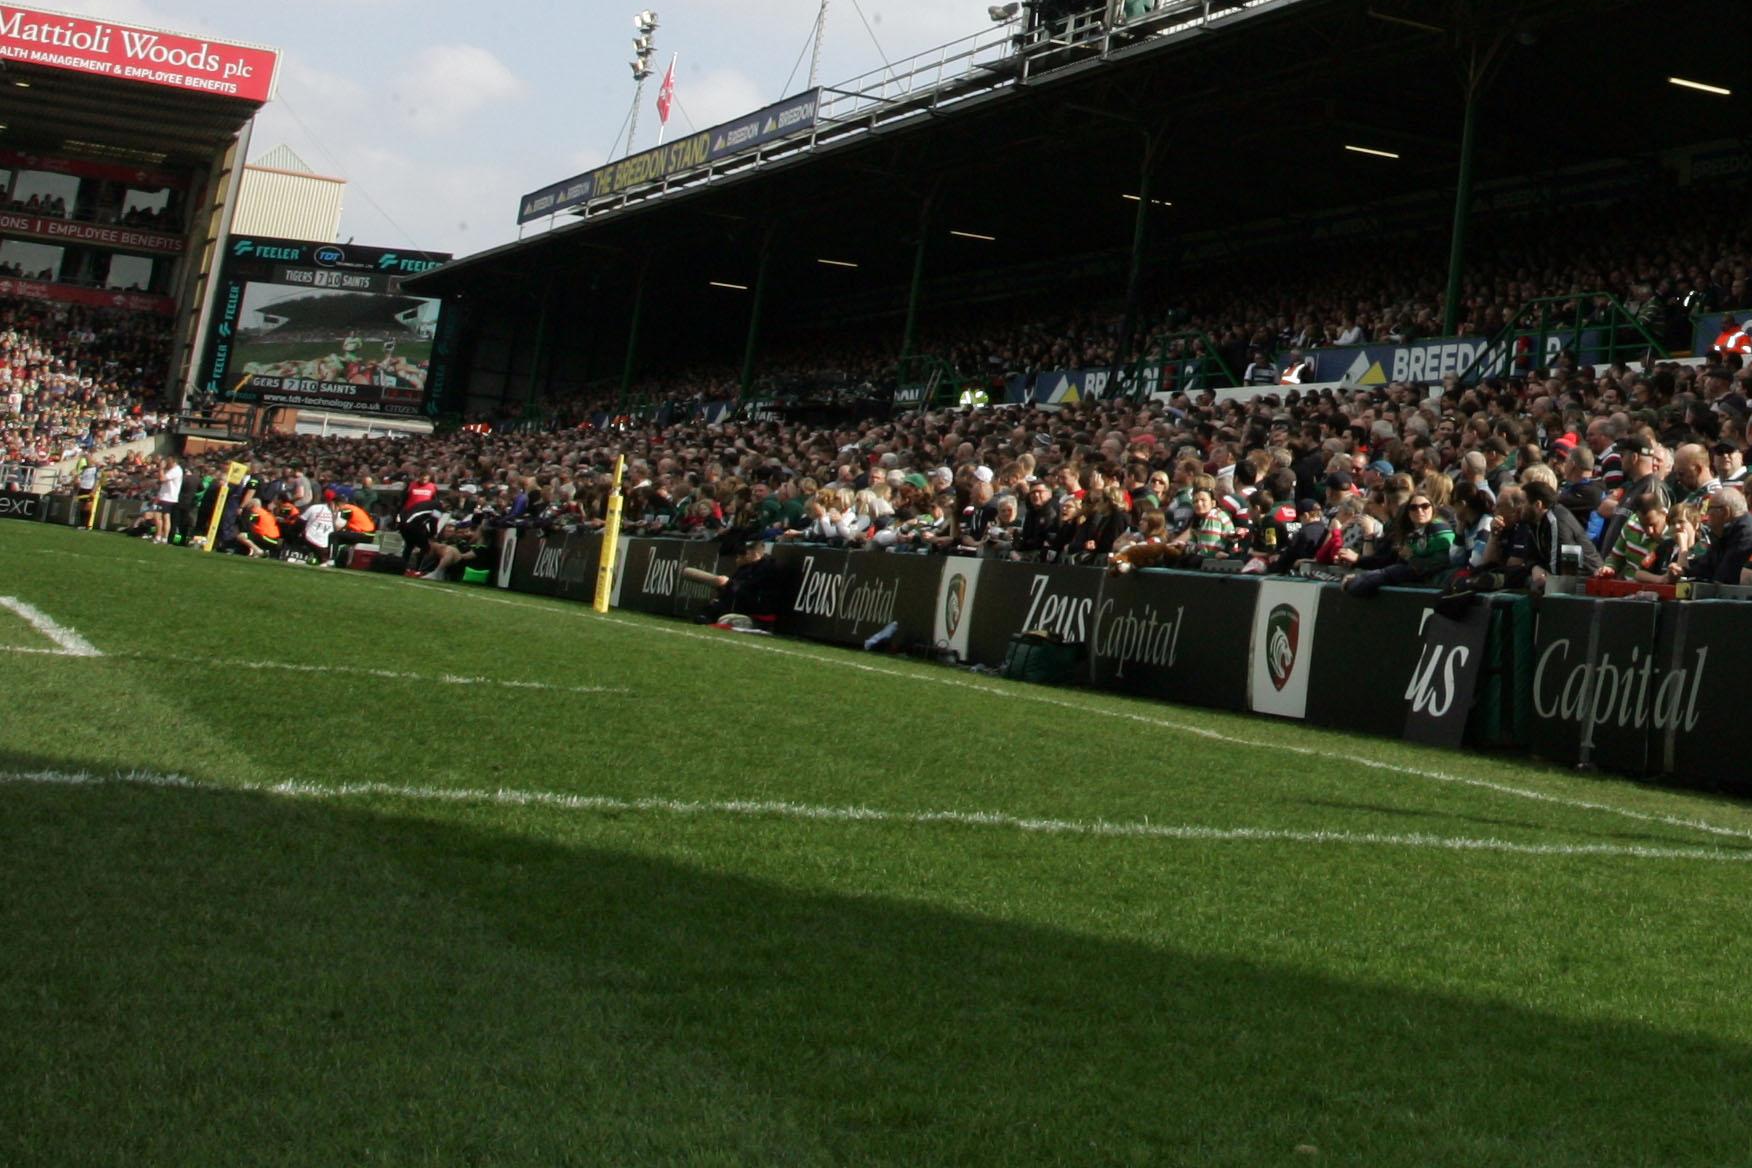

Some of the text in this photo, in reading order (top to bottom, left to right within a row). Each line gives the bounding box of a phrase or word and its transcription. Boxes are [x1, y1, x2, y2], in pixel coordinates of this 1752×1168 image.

[0, 9, 253, 79] Mattioli Woods plc
[31, 50, 112, 73] MANAGEMENT
[113, 63, 122, 75] &
[125, 66, 185, 85] EMPLOYEE
[185, 75, 237, 94] BENEFITS
[778, 102, 815, 128] BREEDON
[593, 132, 710, 197] THE BREEDON STAND
[48, 222, 184, 250] EMPLOYEE BENEFITS
[256, 245, 300, 261] FEELER
[319, 250, 341, 262] TDT
[286, 270, 312, 282] TIGERS
[342, 276, 370, 288] SAINTS
[227, 284, 240, 320] FEELER
[212, 344, 229, 381] FEELER
[253, 377, 280, 389] GERS
[320, 383, 357, 395] SAINTS
[264, 392, 381, 412] www.tdt-technology.co.uk
[533, 538, 563, 580] Zeus
[642, 546, 677, 596] Zeus
[794, 556, 842, 618] Zeus
[839, 572, 899, 635] Capital
[1021, 574, 1185, 679] Zeus Capital
[1404, 637, 1709, 748] us Capital
